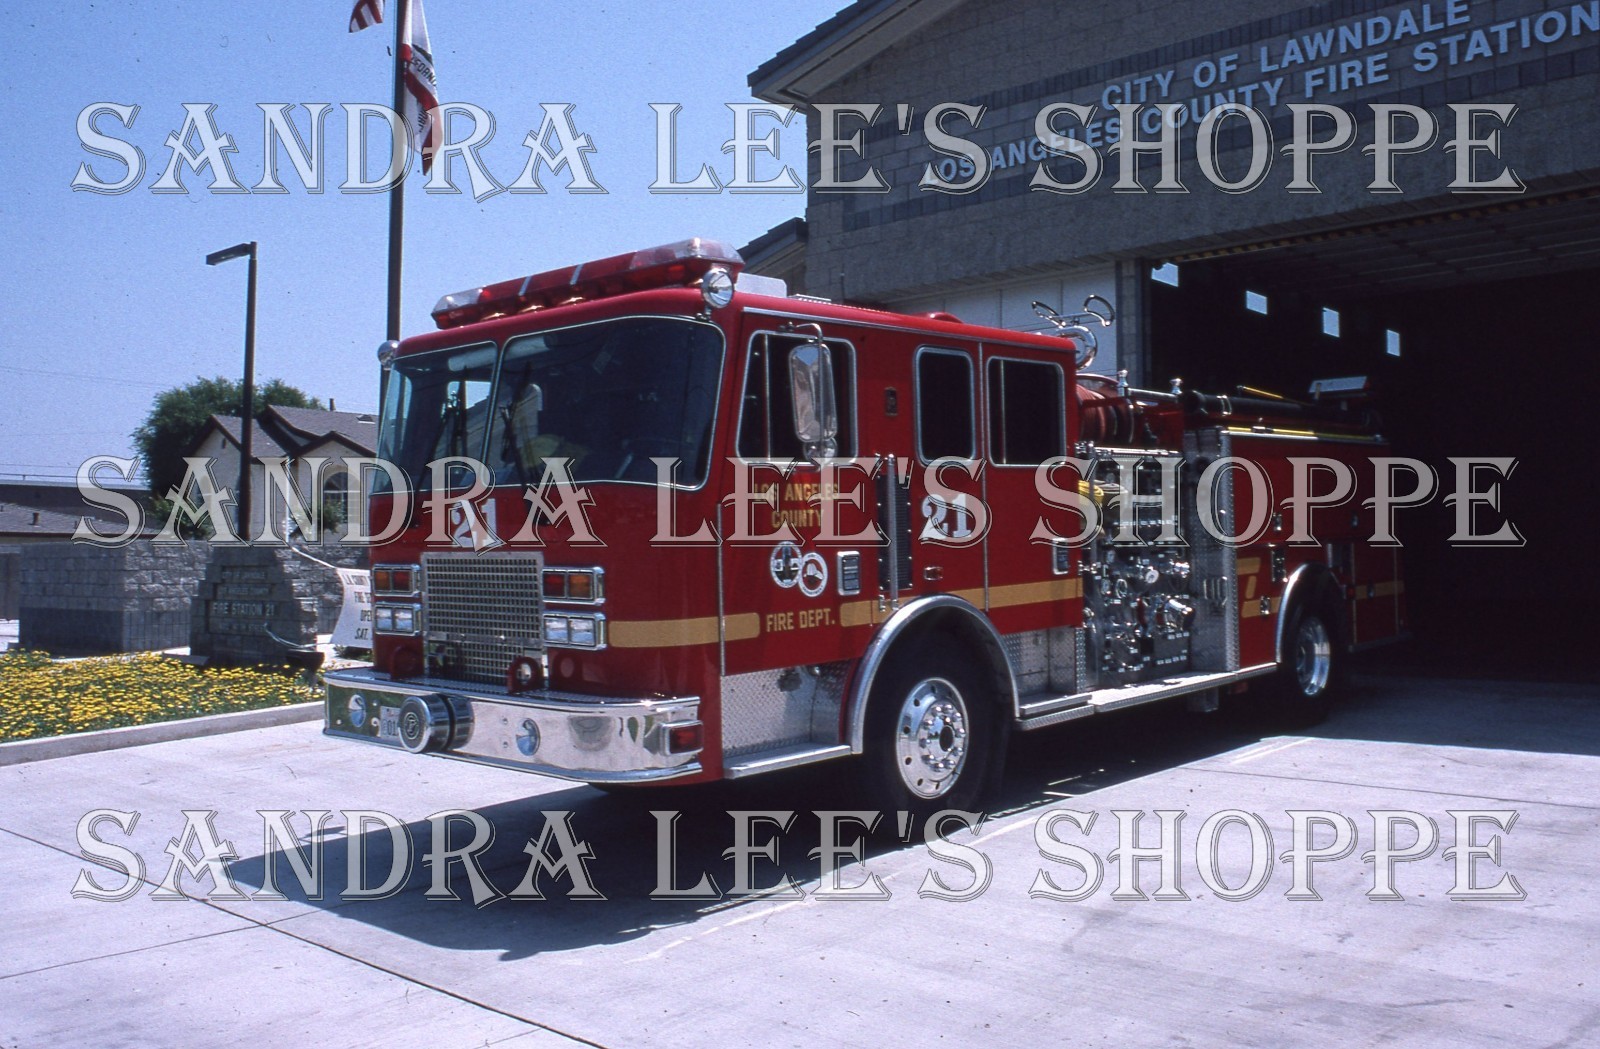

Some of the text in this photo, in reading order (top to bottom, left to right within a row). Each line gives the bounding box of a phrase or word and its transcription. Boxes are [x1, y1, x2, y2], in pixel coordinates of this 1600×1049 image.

[1101, 0, 1472, 111] CITY OF LAWNDALE
[991, 117, 1124, 172] ANGELES
[1140, 78, 1286, 135] COUNTY
[1303, 58, 1390, 100] FIRE
[1412, 8, 1600, 73] STATION
[450, 498, 501, 547] 21
[770, 509, 824, 529] COUNTY
[921, 493, 973, 540] 21
[766, 607, 836, 632] FIRE DEPT.
